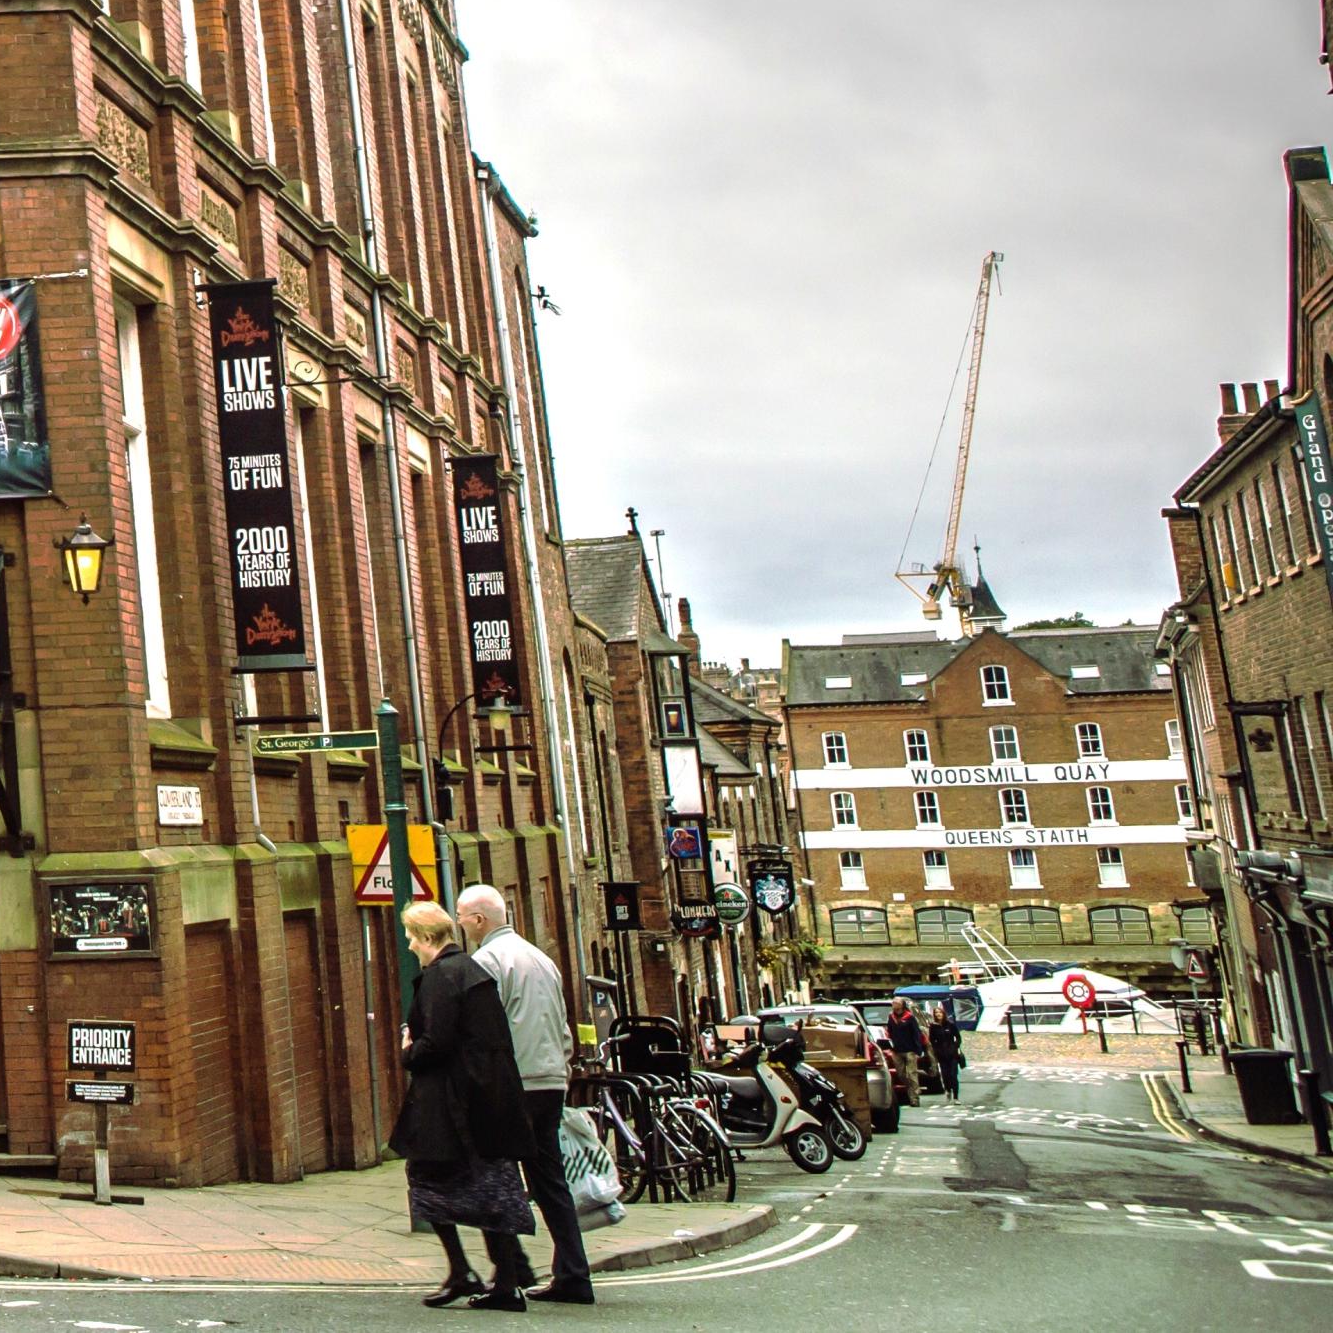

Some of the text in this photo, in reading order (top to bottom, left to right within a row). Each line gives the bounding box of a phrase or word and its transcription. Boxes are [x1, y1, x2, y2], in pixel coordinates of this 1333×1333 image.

[221, 356, 274, 393] LIVE
[224, 389, 275, 412] SHOWS
[228, 453, 281, 470] 75 MINUTES
[230, 467, 282, 491] OF FUN
[461, 506, 498, 531] LIVE
[236, 526, 288, 555] 2000
[463, 528, 499, 544] SHOWS
[237, 553, 290, 570] YEARS OF
[239, 568, 291, 588] HISTORY
[467, 571, 504, 582] 75 MINUTES
[469, 580, 505, 596] OF FUN
[473, 620, 509, 639] 2000
[475, 638, 511, 650] YEARS OF
[476, 649, 512, 662] HISTORY
[261, 740, 273, 749] St.
[275, 738, 314, 749] George's
[911, 764, 1110, 784] WOODSMILL QUAY
[945, 829, 1088, 844] QUEENS STAITH
[374, 877, 394, 889] Flo
[72, 1028, 131, 1048] PRIORITY
[73, 1047, 132, 1066] ENTRANCE
